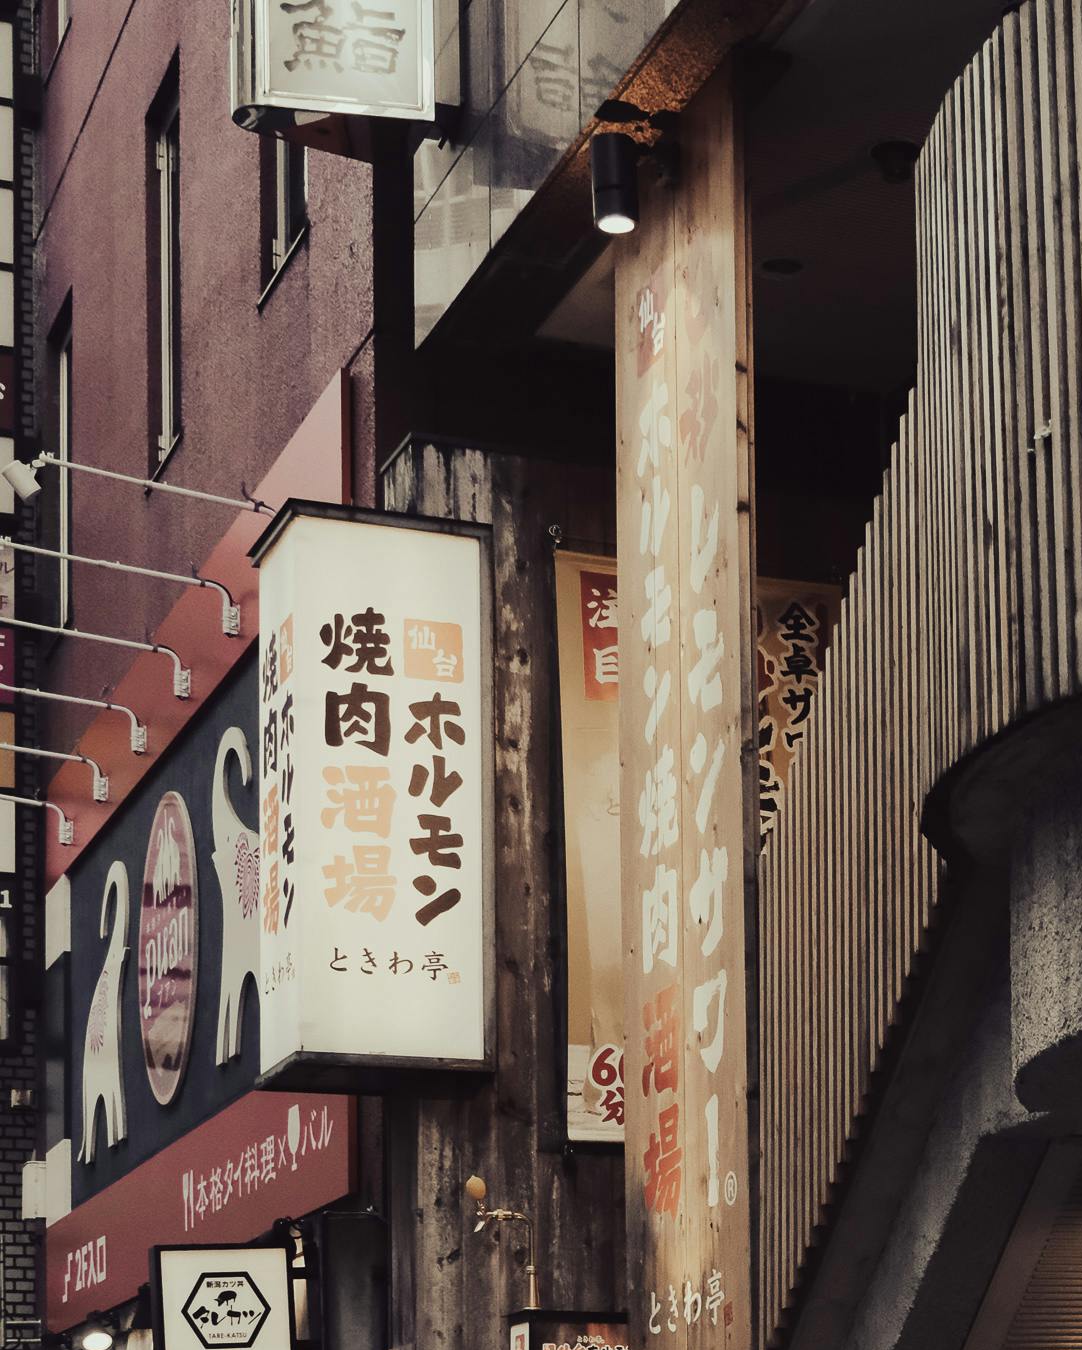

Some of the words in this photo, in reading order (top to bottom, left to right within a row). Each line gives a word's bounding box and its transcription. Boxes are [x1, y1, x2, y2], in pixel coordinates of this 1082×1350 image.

[406, 623, 460, 679] 仙台
[777, 602, 818, 748] 全卓サ
[319, 606, 397, 924] 焼肉酒場
[403, 691, 466, 928] ホルモン
[329, 946, 449, 982] ときわ亭
[592, 1047, 625, 1086] 6
[648, 1269, 725, 1336] ときわ亭
